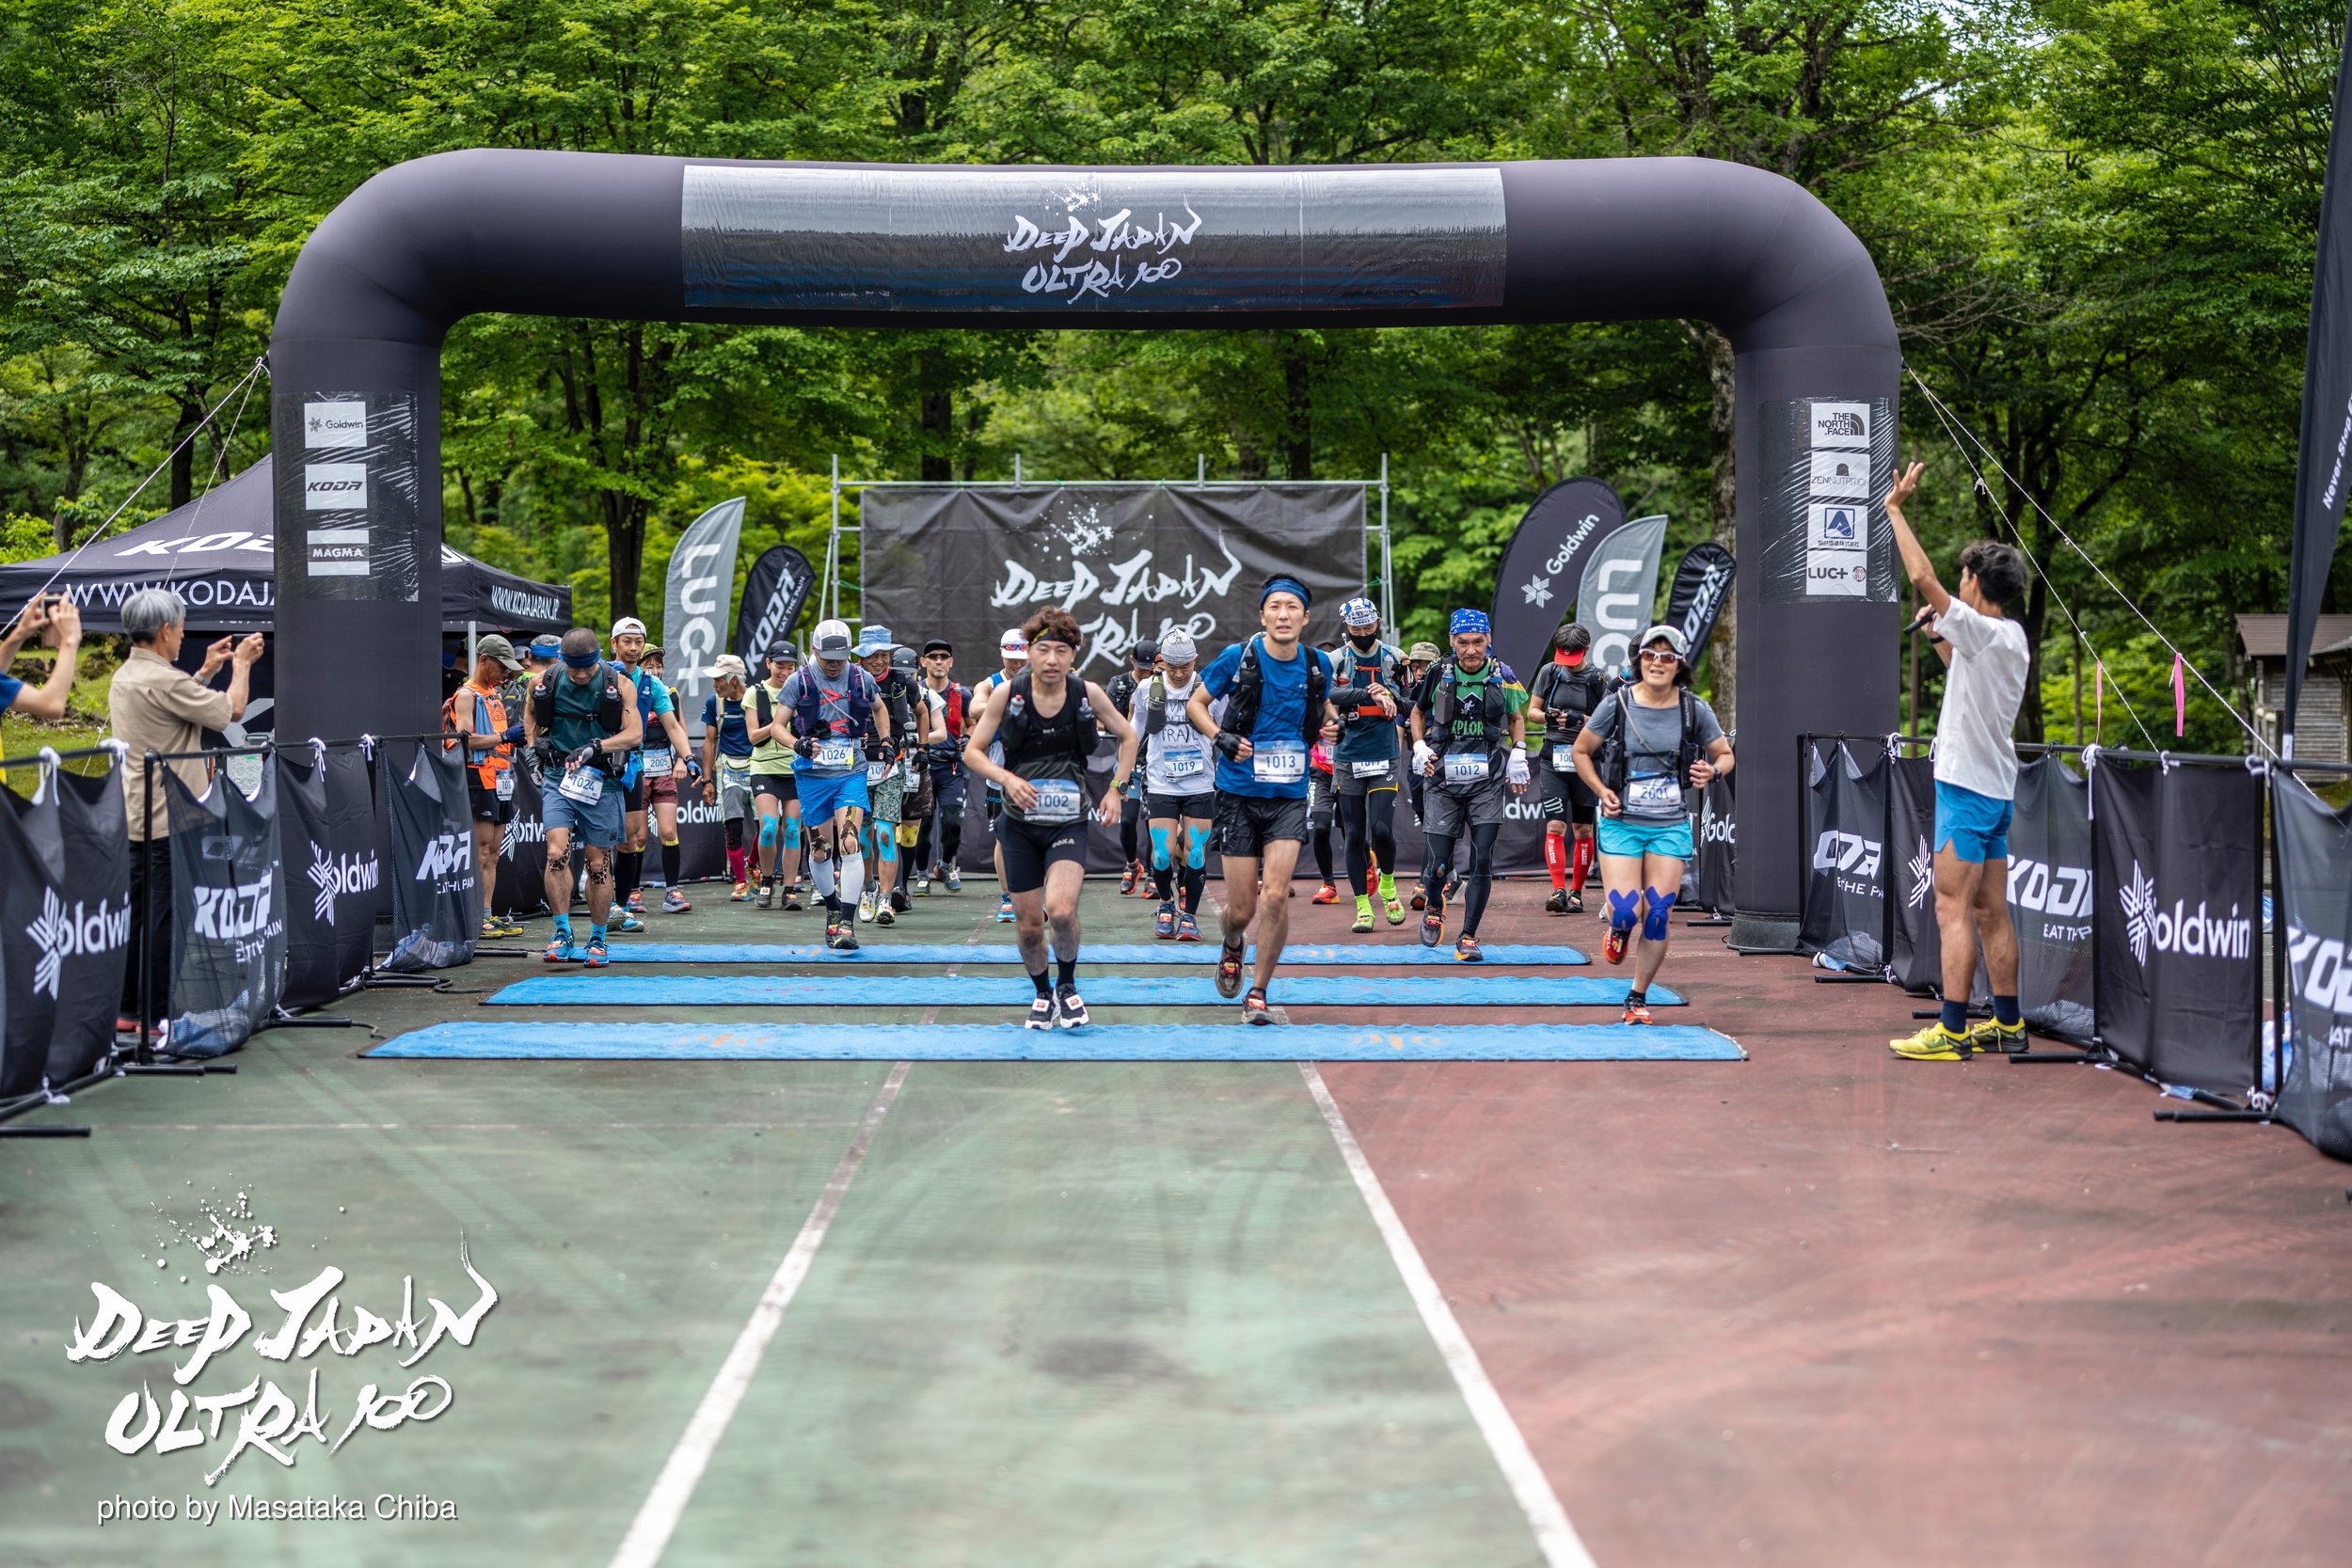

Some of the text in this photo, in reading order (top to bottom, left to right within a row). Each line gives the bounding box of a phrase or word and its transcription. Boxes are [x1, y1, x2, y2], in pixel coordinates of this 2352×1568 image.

[1003, 194, 1202, 263] DEEP JAPAN
[1022, 254, 1182, 305] ULTRA 100
[1833, 412, 1850, 420] THE
[326, 420, 364, 430] Goldwin
[1818, 420, 1850, 428] NORTH
[1827, 427, 1850, 436] FACE
[307, 481, 363, 492] KODA
[2322, 457, 2343, 511] Never
[1546, 514, 1601, 575] Goldwin
[312, 547, 363, 558] MAGMA
[1099, 527, 1242, 610] JAPAN
[778, 576, 805, 633] EAT THE PAIN
[744, 567, 795, 677] KODA
[1452, 720, 1484, 736] XPLOR
[821, 750, 846, 760] 1026
[650, 758, 668, 768] 2005
[1172, 762, 1195, 771] 1019
[1265, 756, 1295, 768] 1013
[1454, 766, 1480, 776] 1012
[572, 776, 595, 791] 1024
[1641, 786, 1669, 800] 2001
[1038, 795, 1069, 807] 1002
[330, 849, 379, 894] oldwin
[2154, 899, 2250, 959] oldwin
